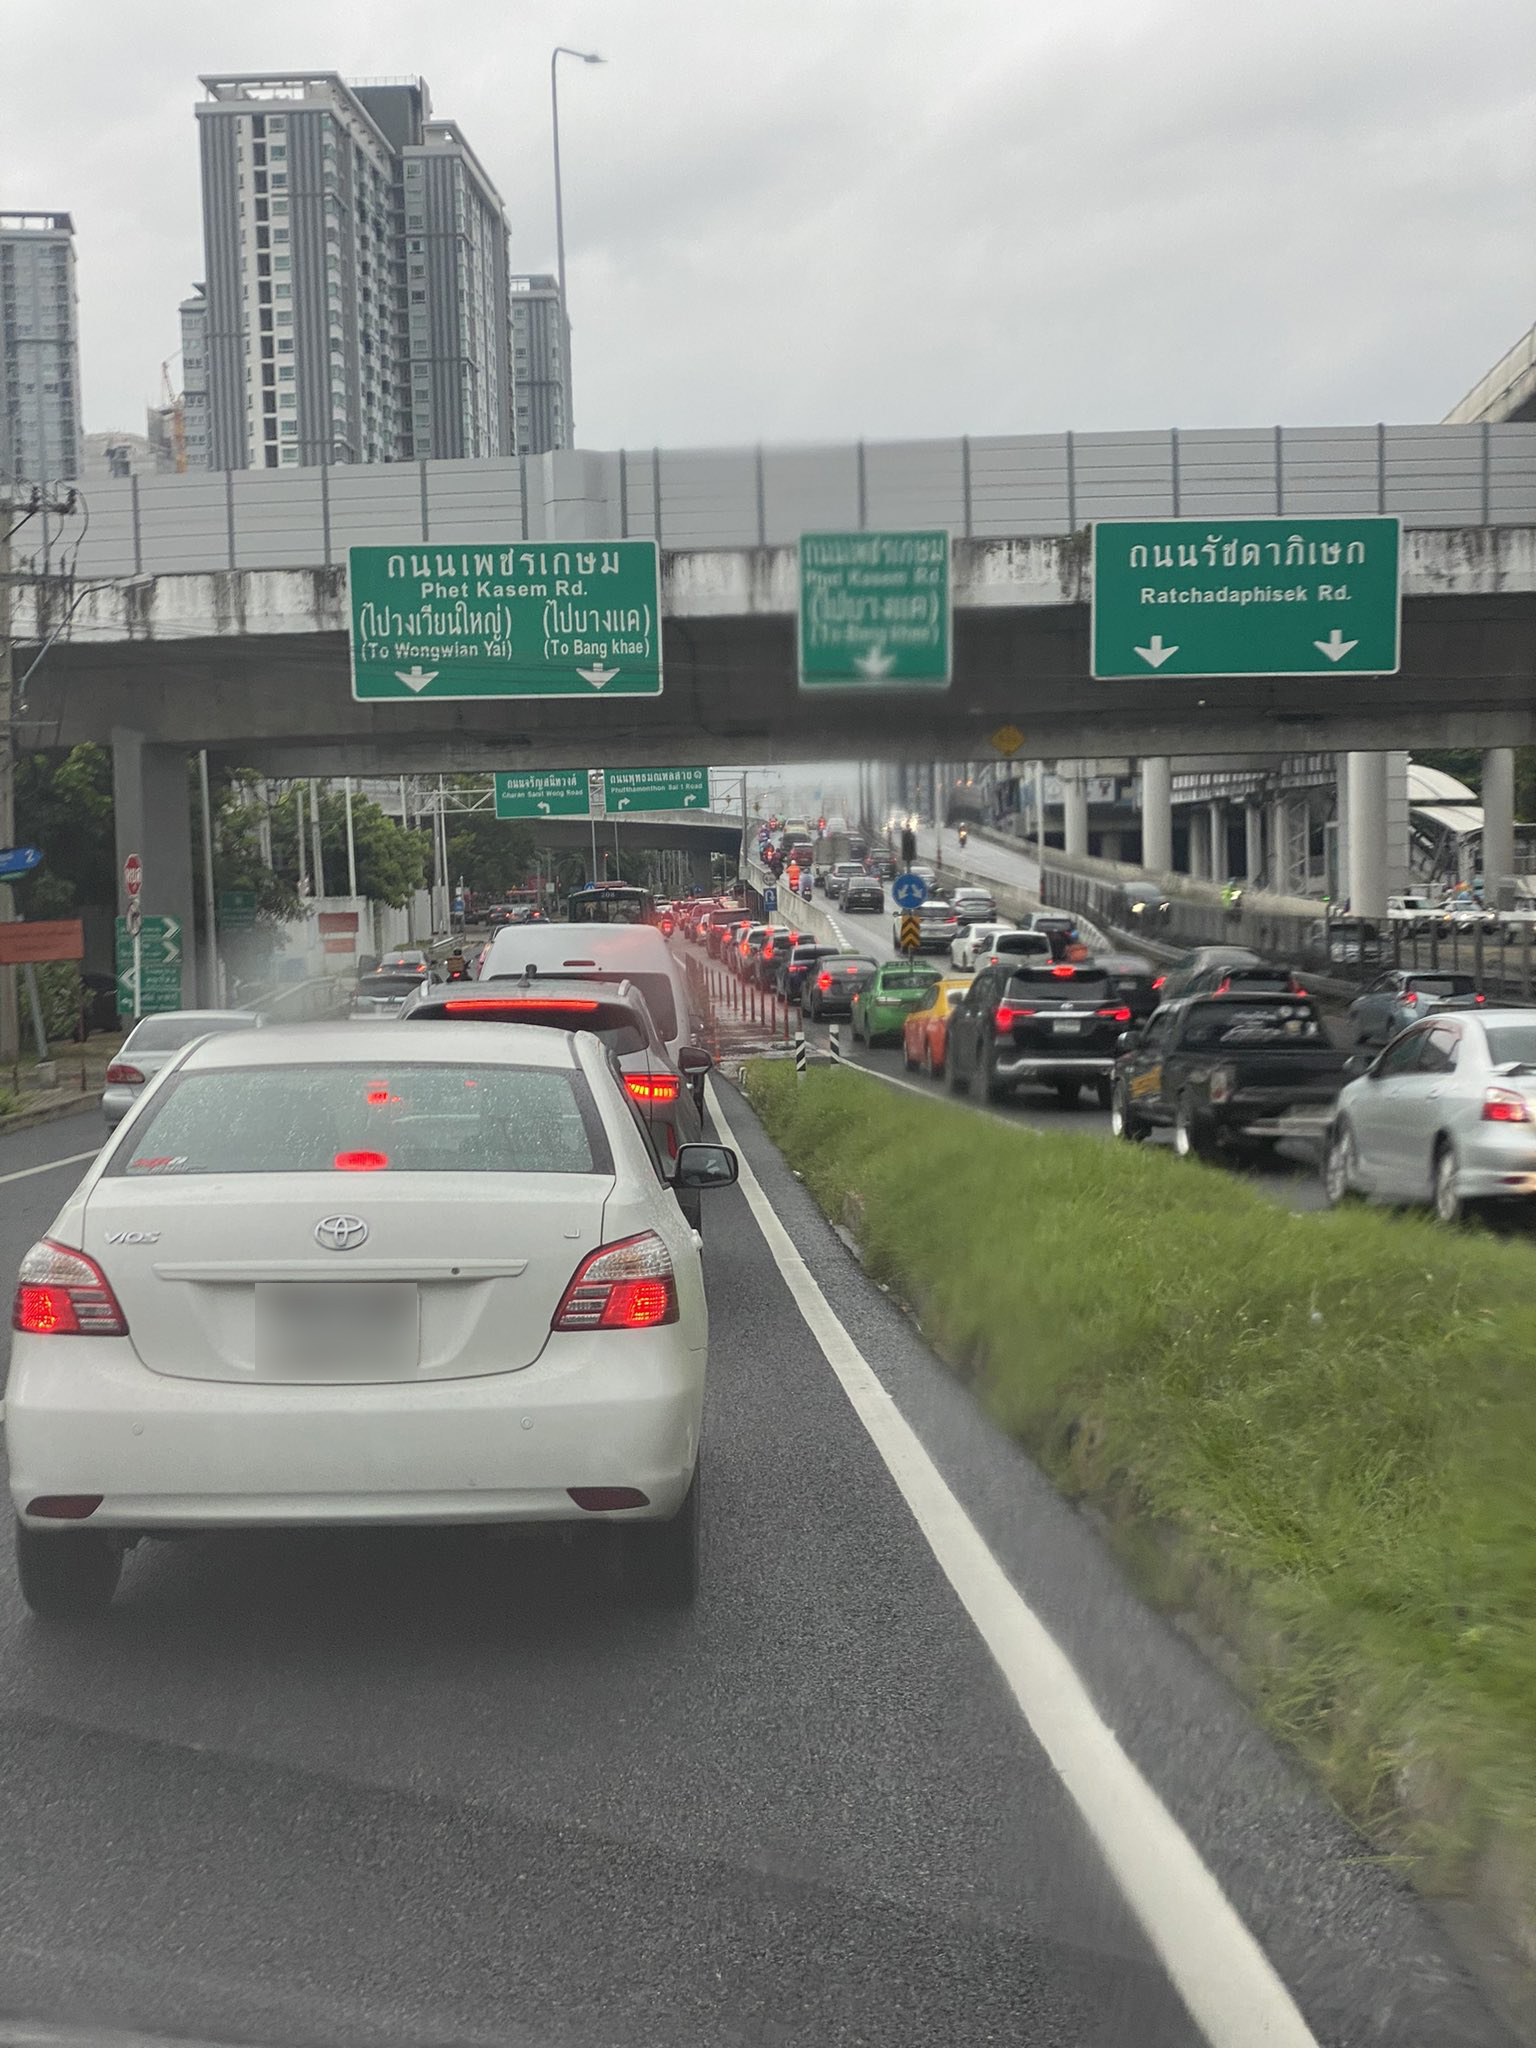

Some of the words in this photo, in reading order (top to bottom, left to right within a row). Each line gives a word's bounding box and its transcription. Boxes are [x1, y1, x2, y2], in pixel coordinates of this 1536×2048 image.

[1130, 534, 1366, 568] ถนนรัชดาภิเษก
[387, 548, 619, 577] ถนนเพชรเกษม
[421, 582, 469, 599] Phet
[476, 581, 547, 598] Kasem
[555, 580, 588, 596] Rd.
[1140, 585, 1308, 606] Ratchadaphisek
[1317, 584, 1352, 601] Rd.
[360, 601, 512, 641] (ไปวงเวียนใหญ่)
[543, 599, 650, 639] (ไปบางแค)
[361, 642, 389, 662] (To
[395, 641, 479, 662] Wongwian
[484, 640, 513, 661] Yai)
[544, 639, 569, 660] (To
[574, 639, 607, 659] Bang
[612, 638, 650, 658] khae)
[546, 789, 565, 798] Wong
[104, 1231, 161, 1245] VIOS
